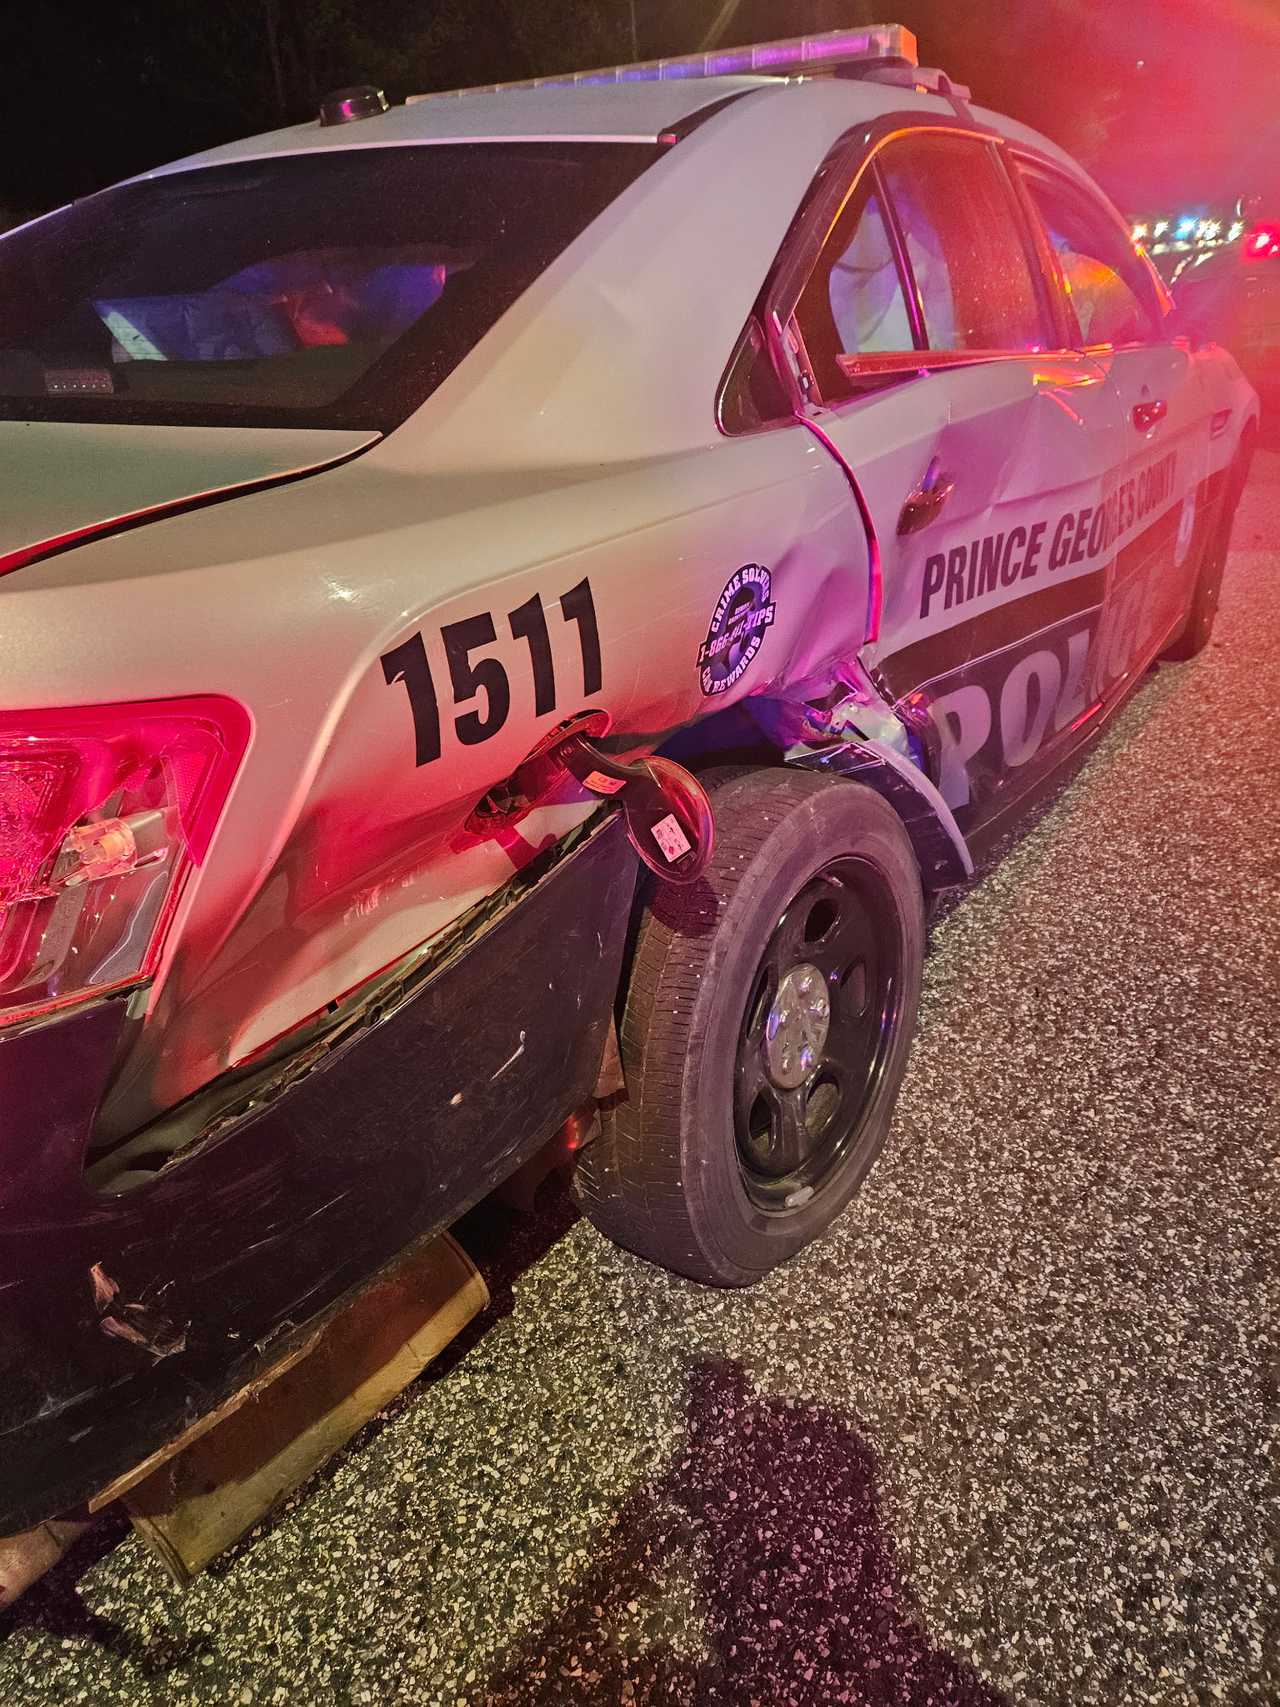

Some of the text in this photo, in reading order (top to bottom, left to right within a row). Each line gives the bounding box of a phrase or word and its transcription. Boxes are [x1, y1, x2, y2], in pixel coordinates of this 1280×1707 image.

[712, 574, 741, 633] CRIME
[920, 521, 1047, 619] PRINCE
[380, 576, 602, 767] 1511
[711, 636, 761, 693] REWARDS
